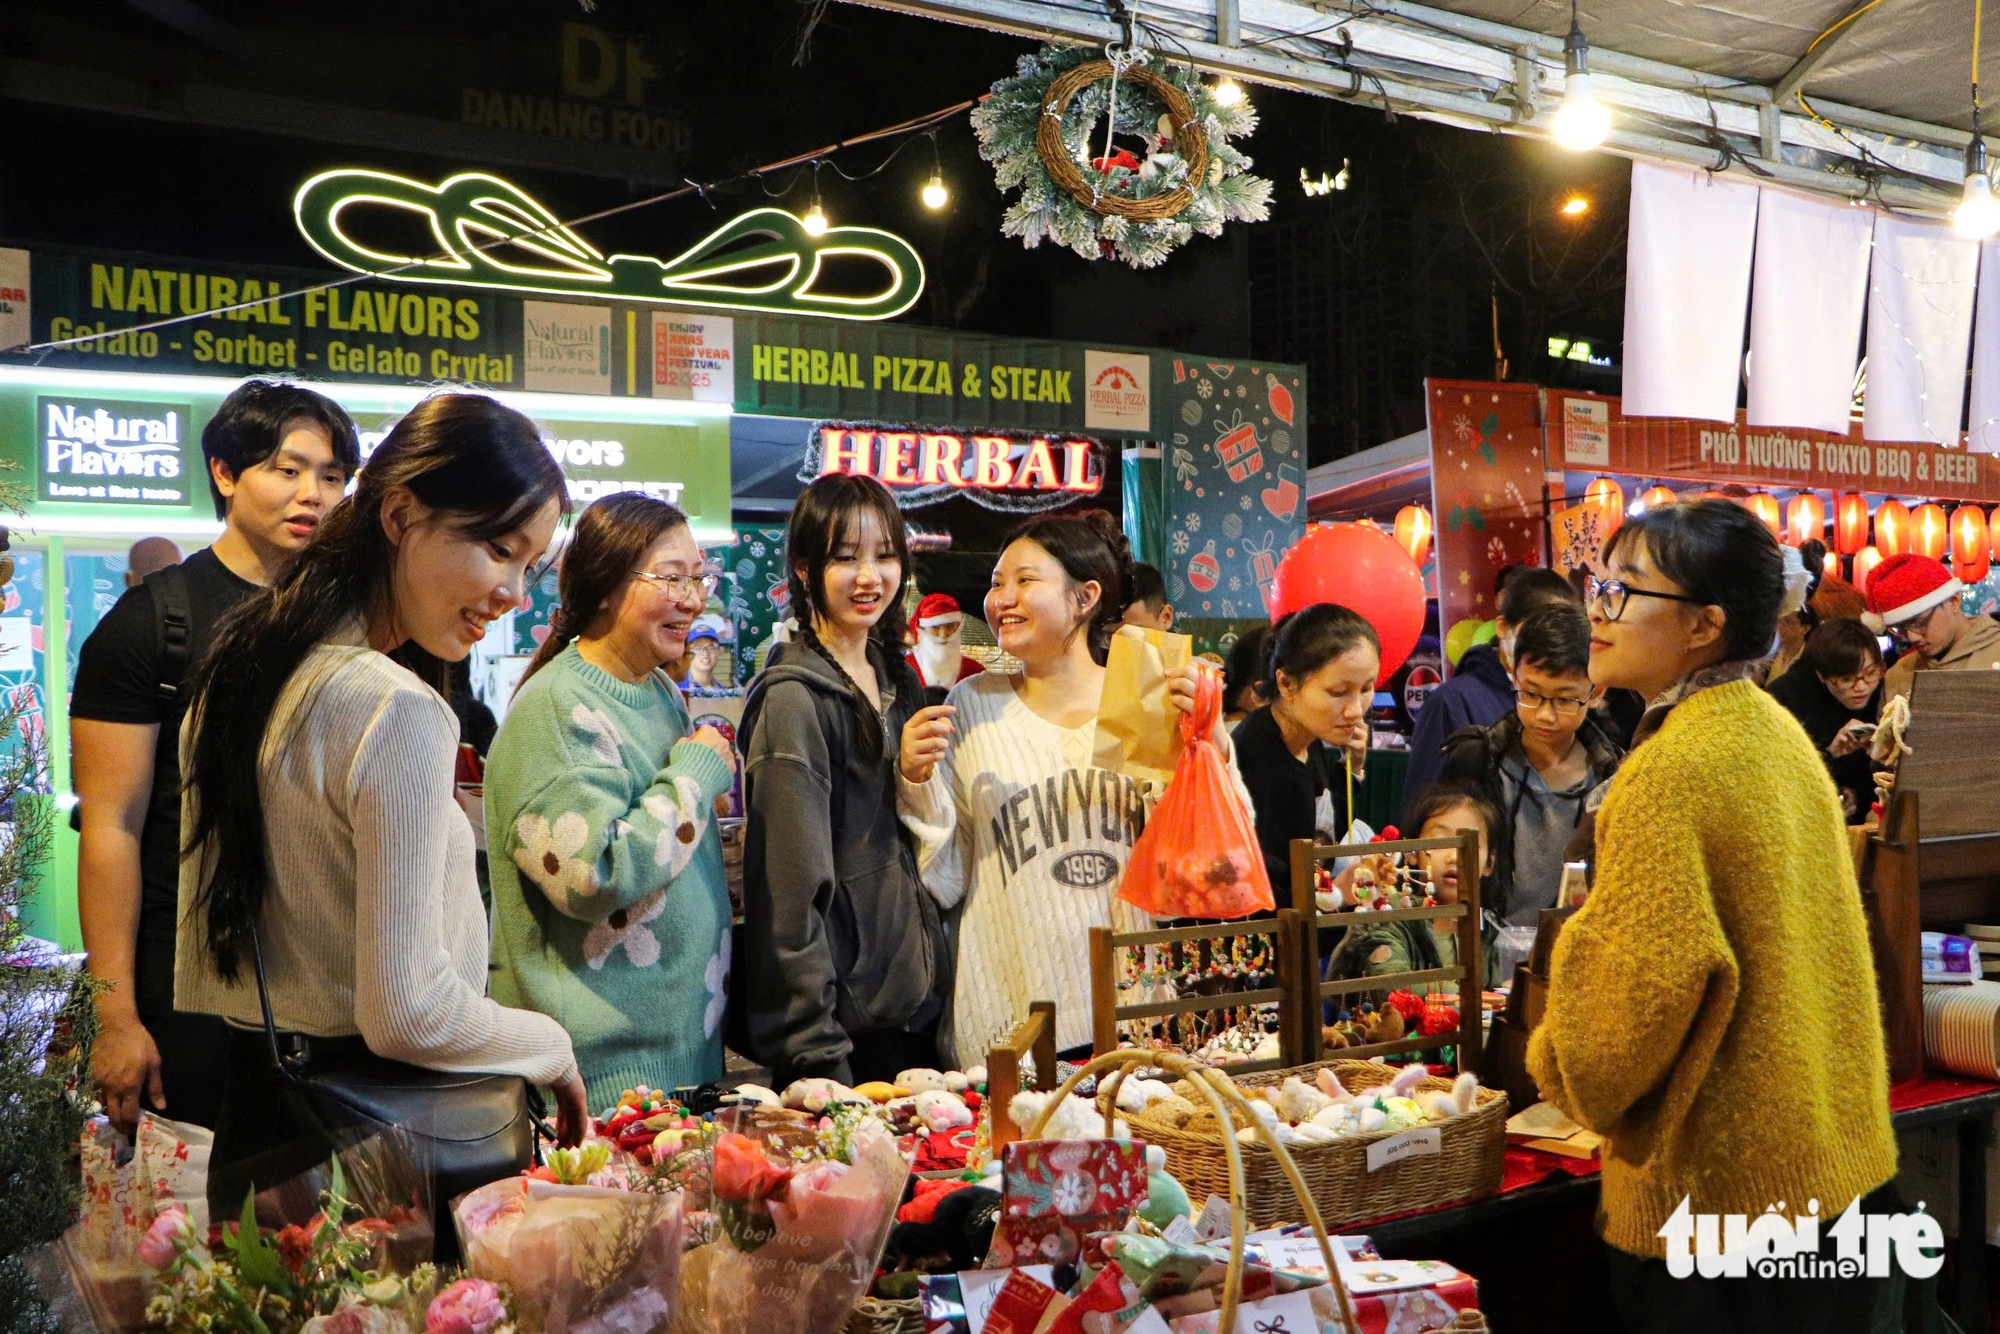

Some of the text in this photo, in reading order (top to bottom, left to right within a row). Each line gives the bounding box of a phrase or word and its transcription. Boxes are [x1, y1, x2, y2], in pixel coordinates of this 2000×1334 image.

[463, 87, 606, 142] DANANG
[92, 264, 480, 340] NATURAL FLAVORS
[51, 317, 159, 357] Gelato
[193, 330, 298, 368] Sorbet
[327, 341, 421, 377] Gelato
[430, 348, 513, 383] Crytal
[668, 322, 704, 334] ENJOY
[668, 358, 722, 370] FESTIVAL
[698, 349, 731, 360] YEAR
[752, 344, 1072, 404] HERBAL PIZZA & STEAK
[1090, 390, 1147, 406] HERBAL PIZZA
[47, 404, 179, 449] Natural
[47, 439, 180, 478] Flavors
[820, 428, 1101, 493] HERBAL
[1816, 441, 1871, 476] TOKYO
[1876, 448, 1910, 482] BBQ
[1917, 453, 1929, 481] &
[1935, 452, 1978, 485] BEER
[992, 768, 1152, 889] NEWYOR
[1063, 854, 1107, 884] 1996
